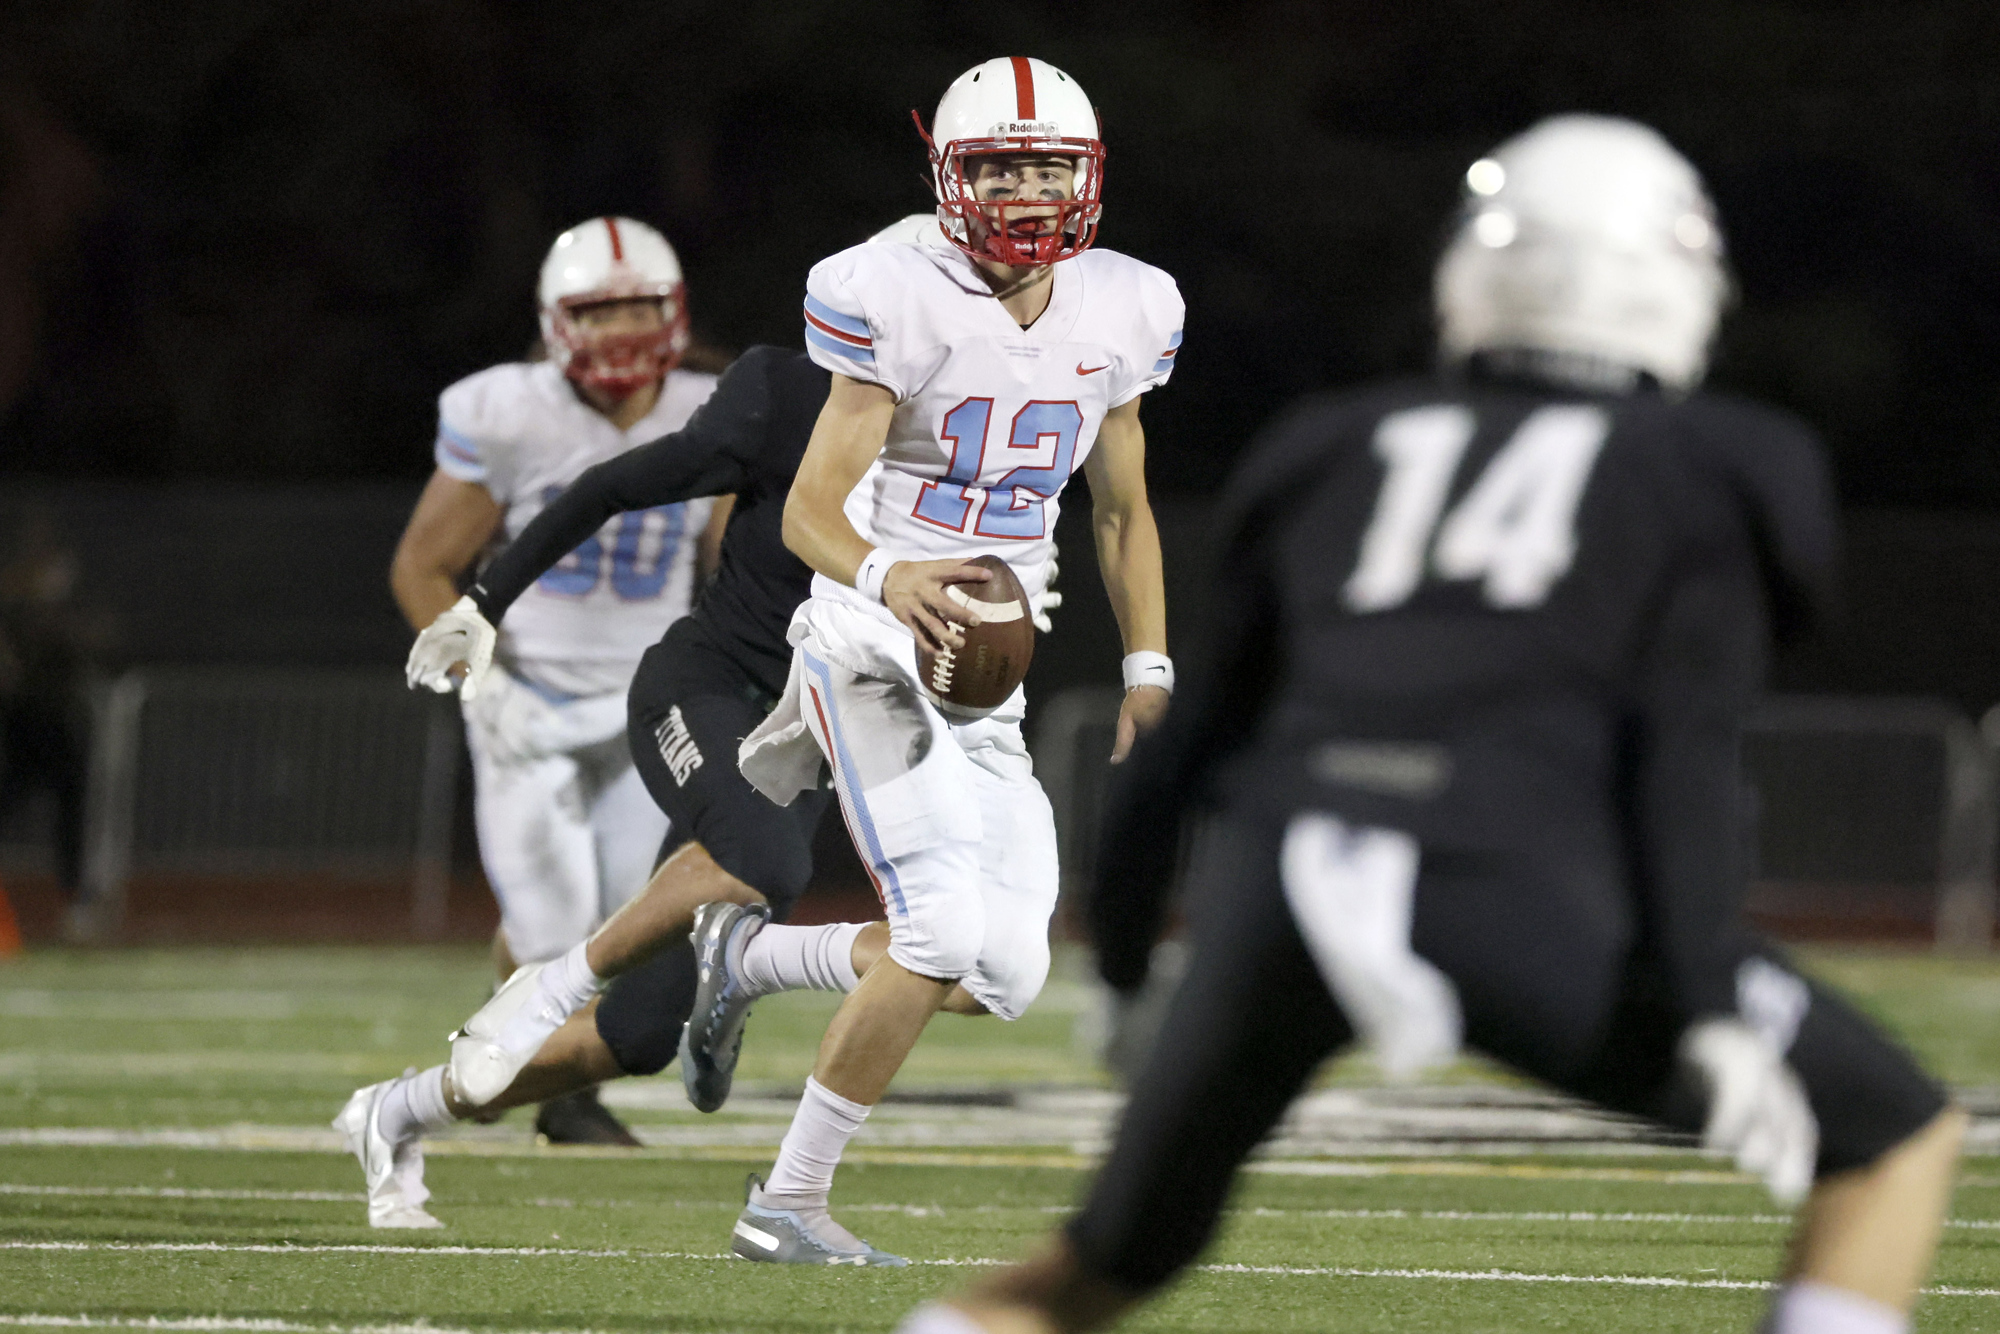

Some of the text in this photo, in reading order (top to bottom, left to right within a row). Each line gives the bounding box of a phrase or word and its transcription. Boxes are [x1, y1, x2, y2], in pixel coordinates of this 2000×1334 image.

[1009, 123, 1046, 133] Riddell
[911, 396, 1084, 540] 12
[1340, 403, 1612, 614] 14
[655, 704, 704, 787] TITANS
